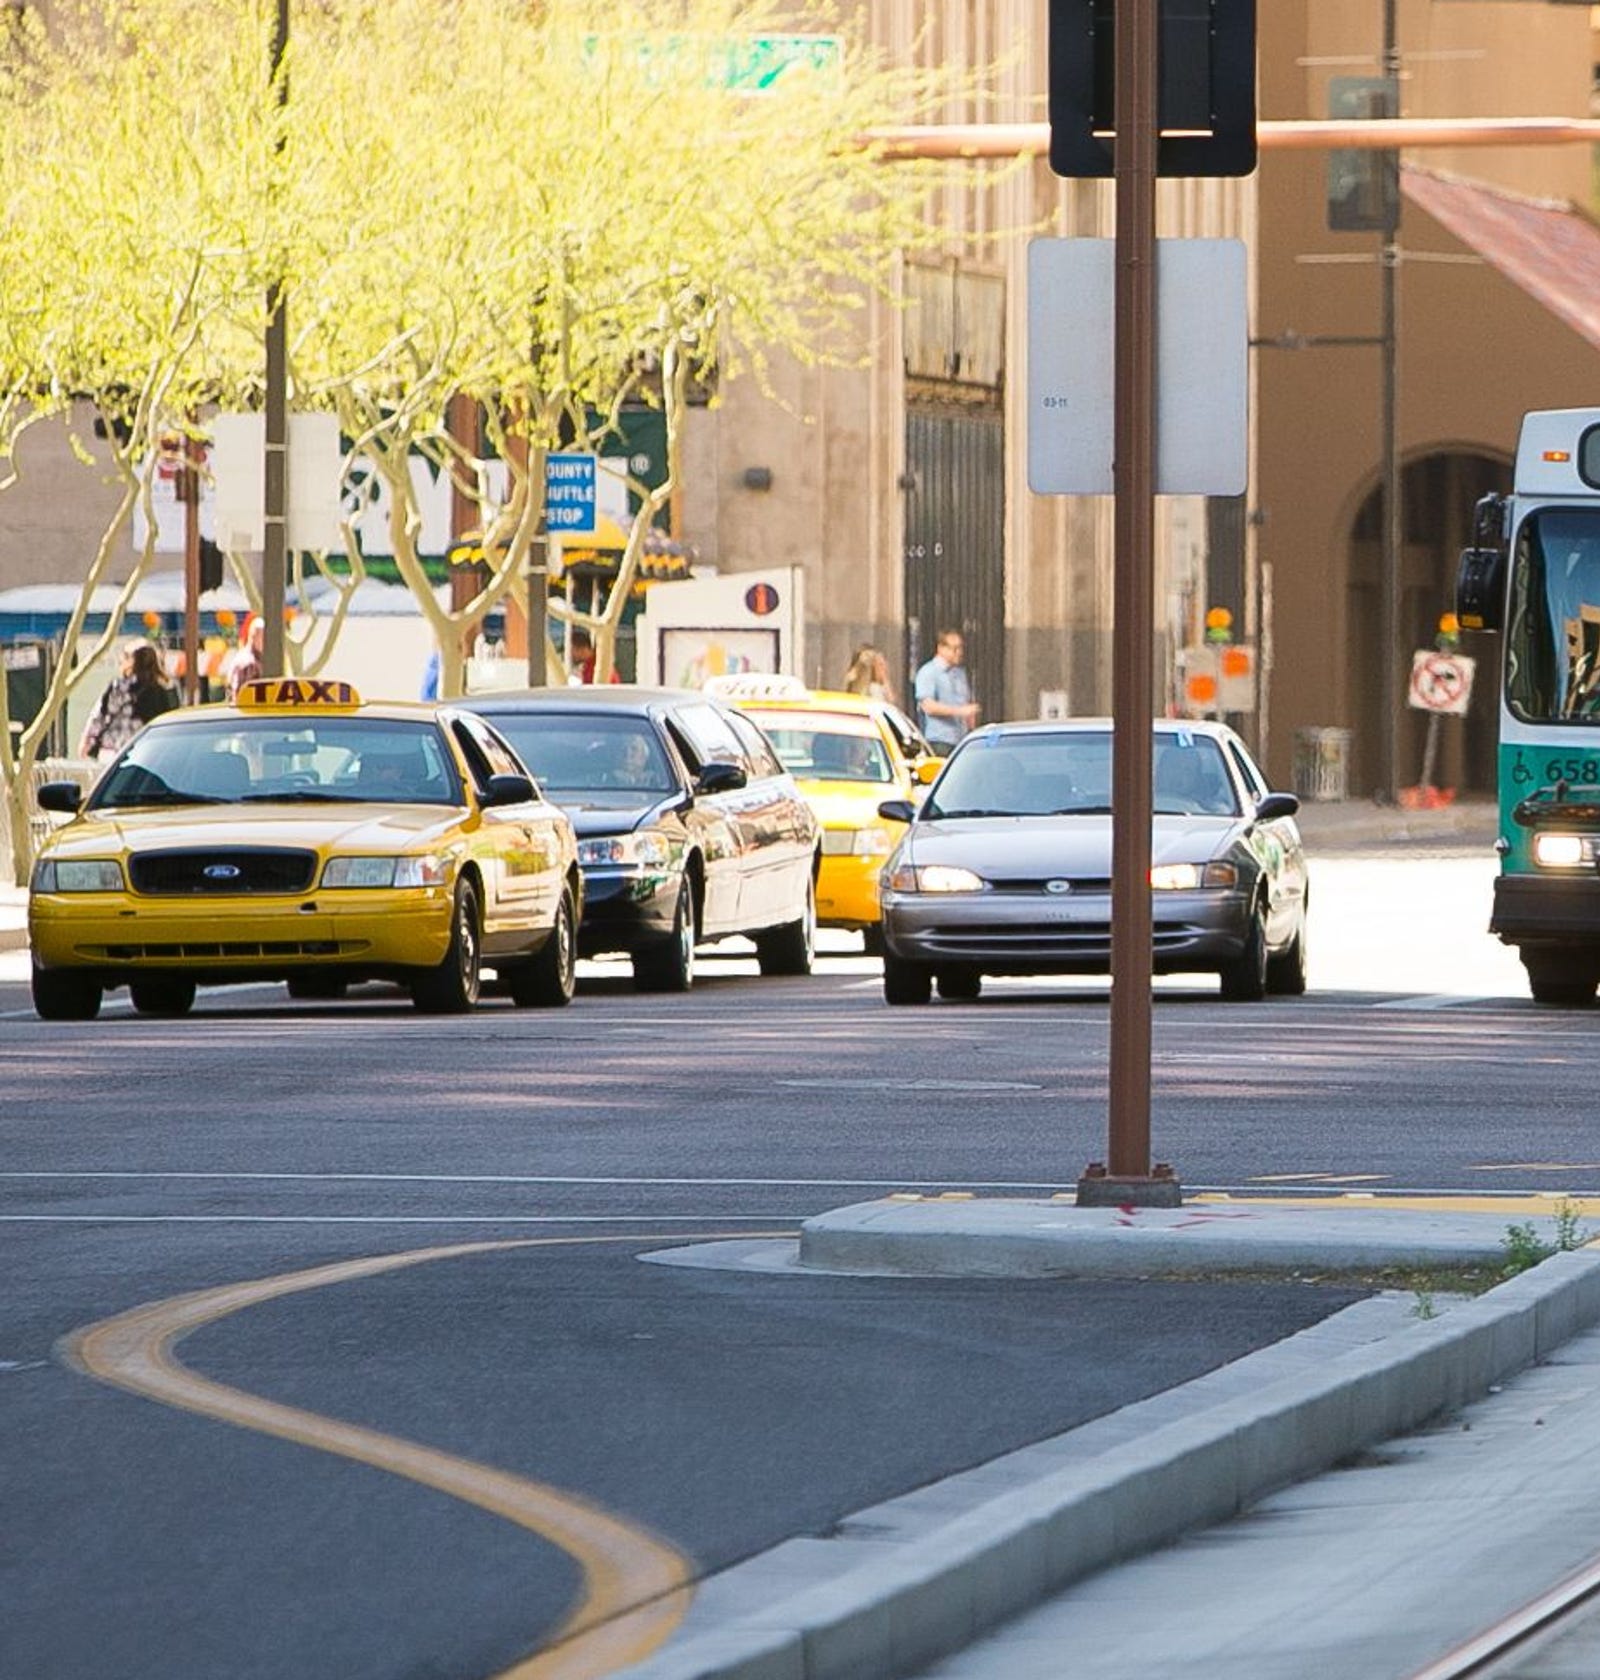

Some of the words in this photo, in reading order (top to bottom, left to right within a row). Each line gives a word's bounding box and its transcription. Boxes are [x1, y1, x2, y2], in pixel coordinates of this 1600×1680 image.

[546, 462, 592, 479] OUNTY
[547, 507, 584, 525] STOP
[247, 680, 351, 703] TAXI
